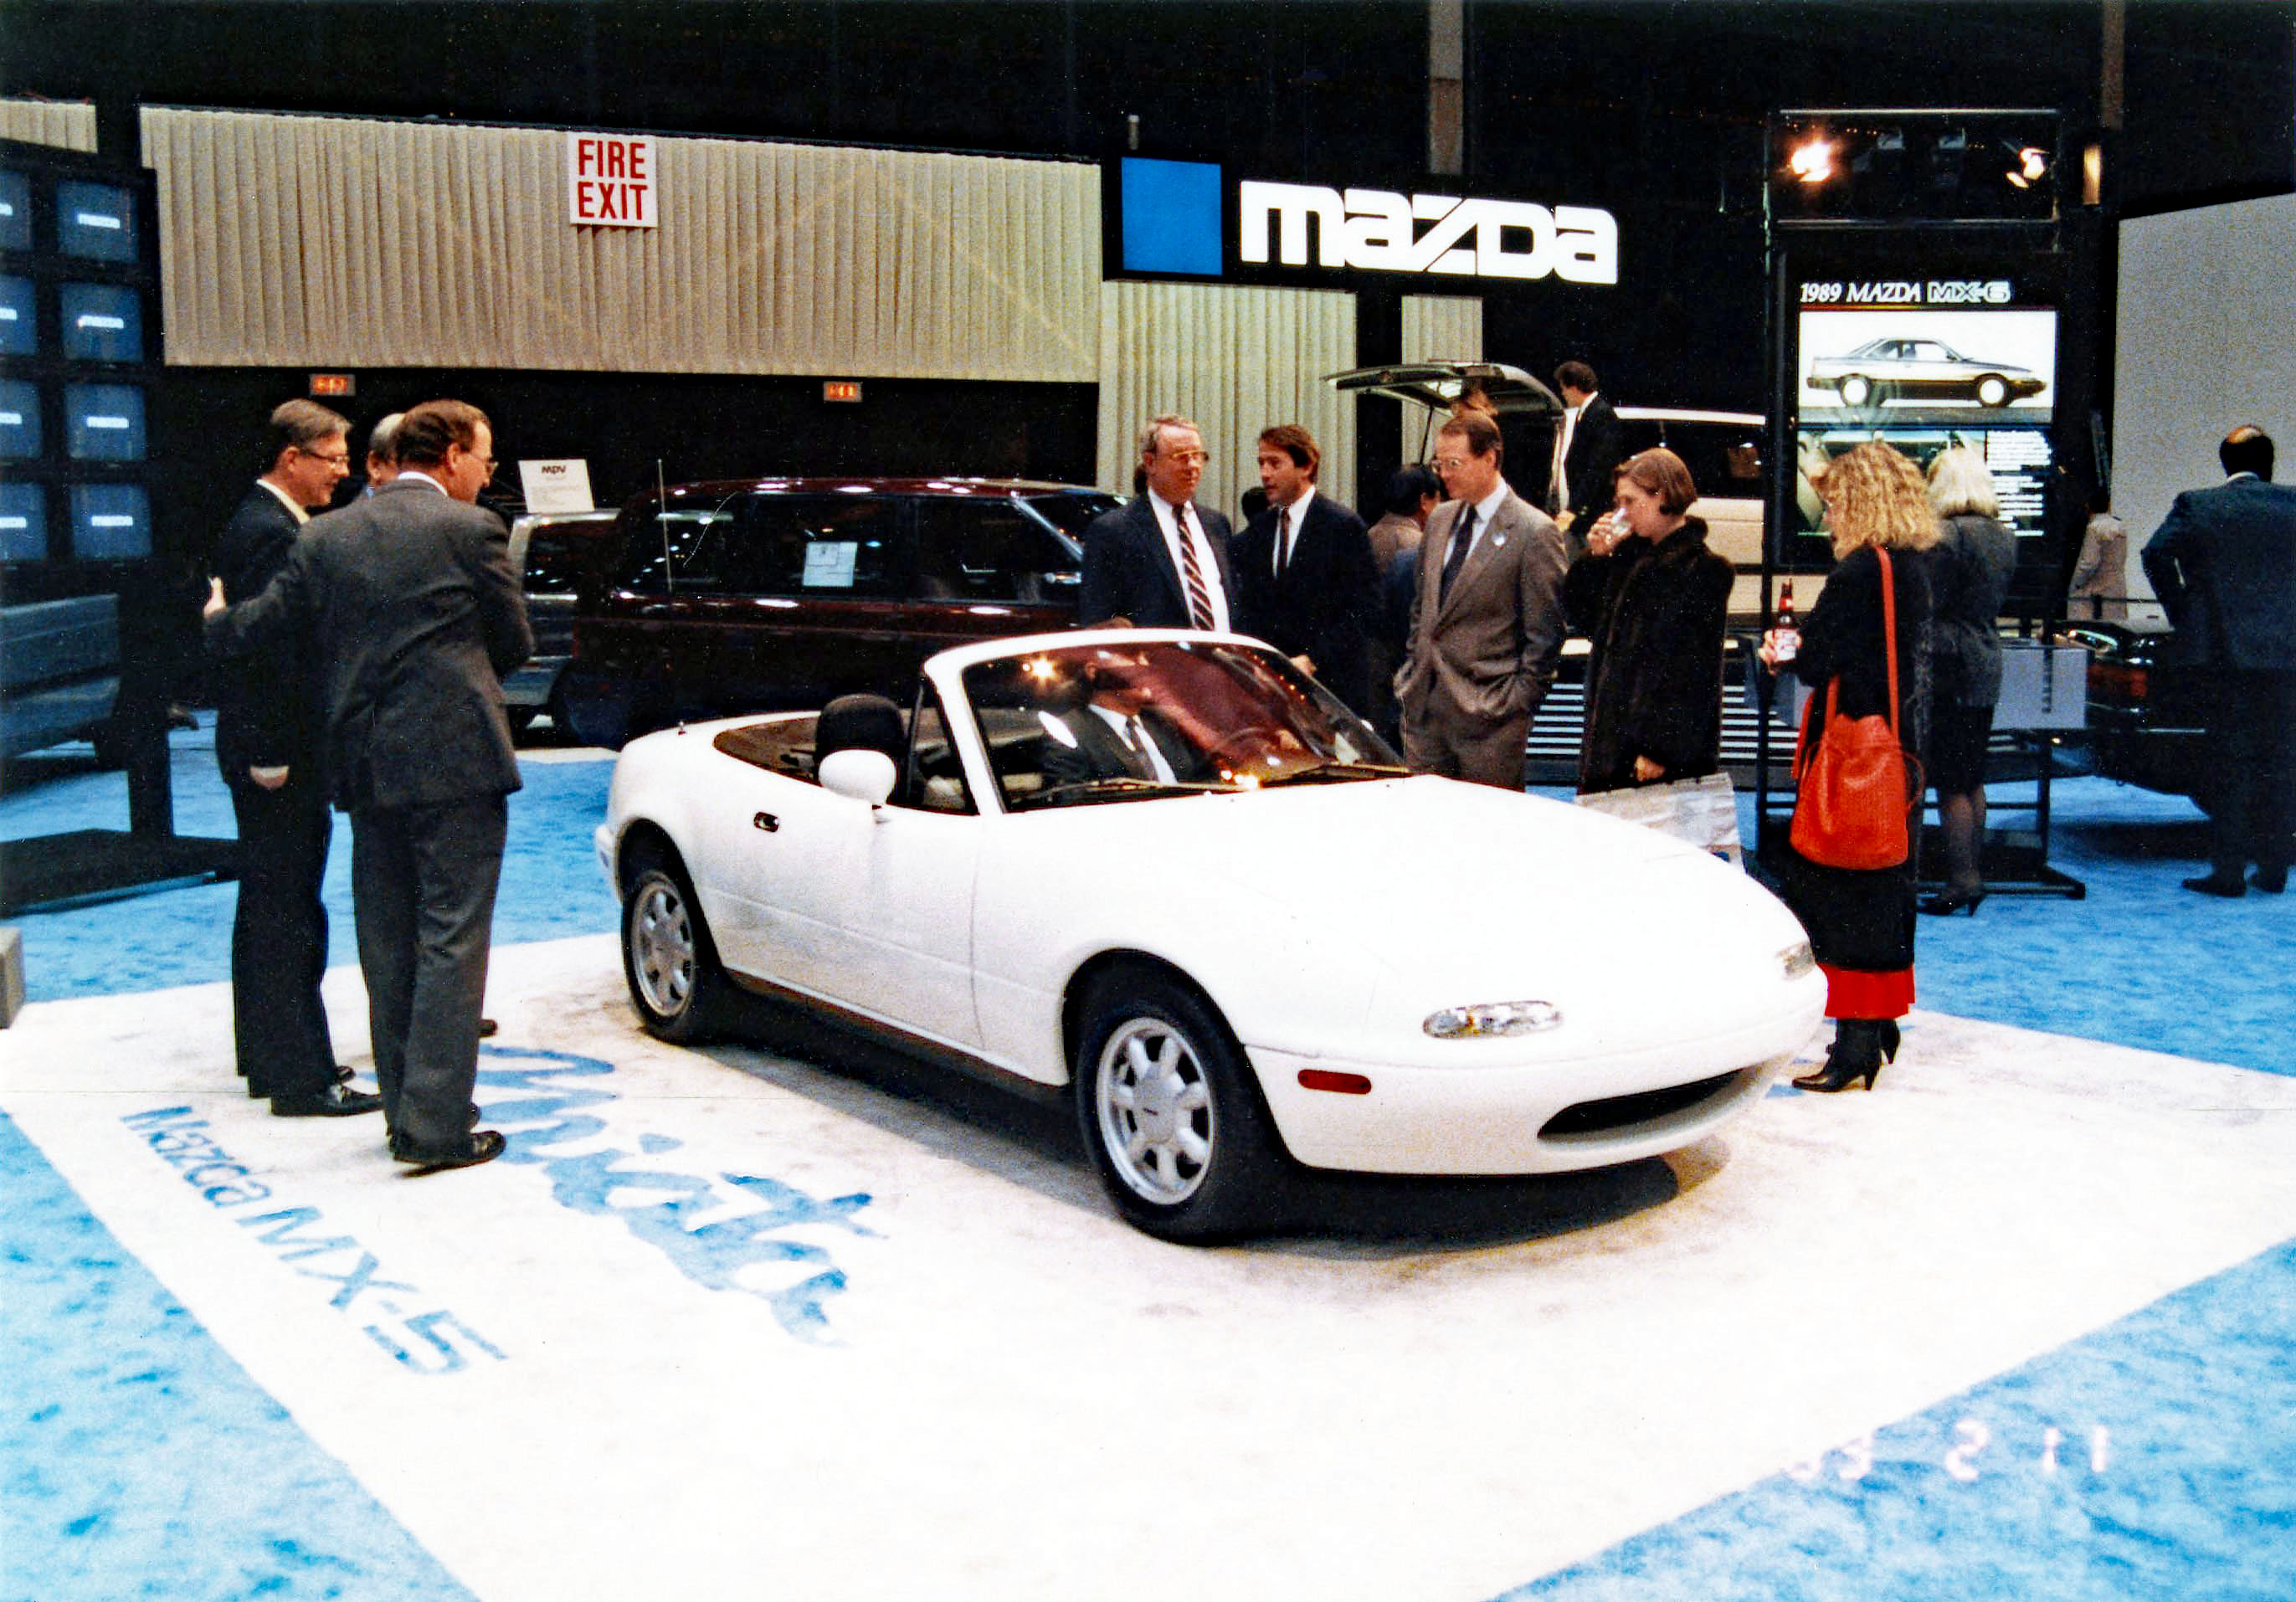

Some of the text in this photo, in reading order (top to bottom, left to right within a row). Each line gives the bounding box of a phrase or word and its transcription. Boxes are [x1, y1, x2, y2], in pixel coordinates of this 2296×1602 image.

[578, 139, 646, 179] FIRE
[578, 181, 649, 221] EXIT
[1240, 180, 1619, 285] mazda
[1800, 280, 2011, 304] 1989 MAZDA MX-6
[121, 1105, 509, 1377] Mazda MX-5
